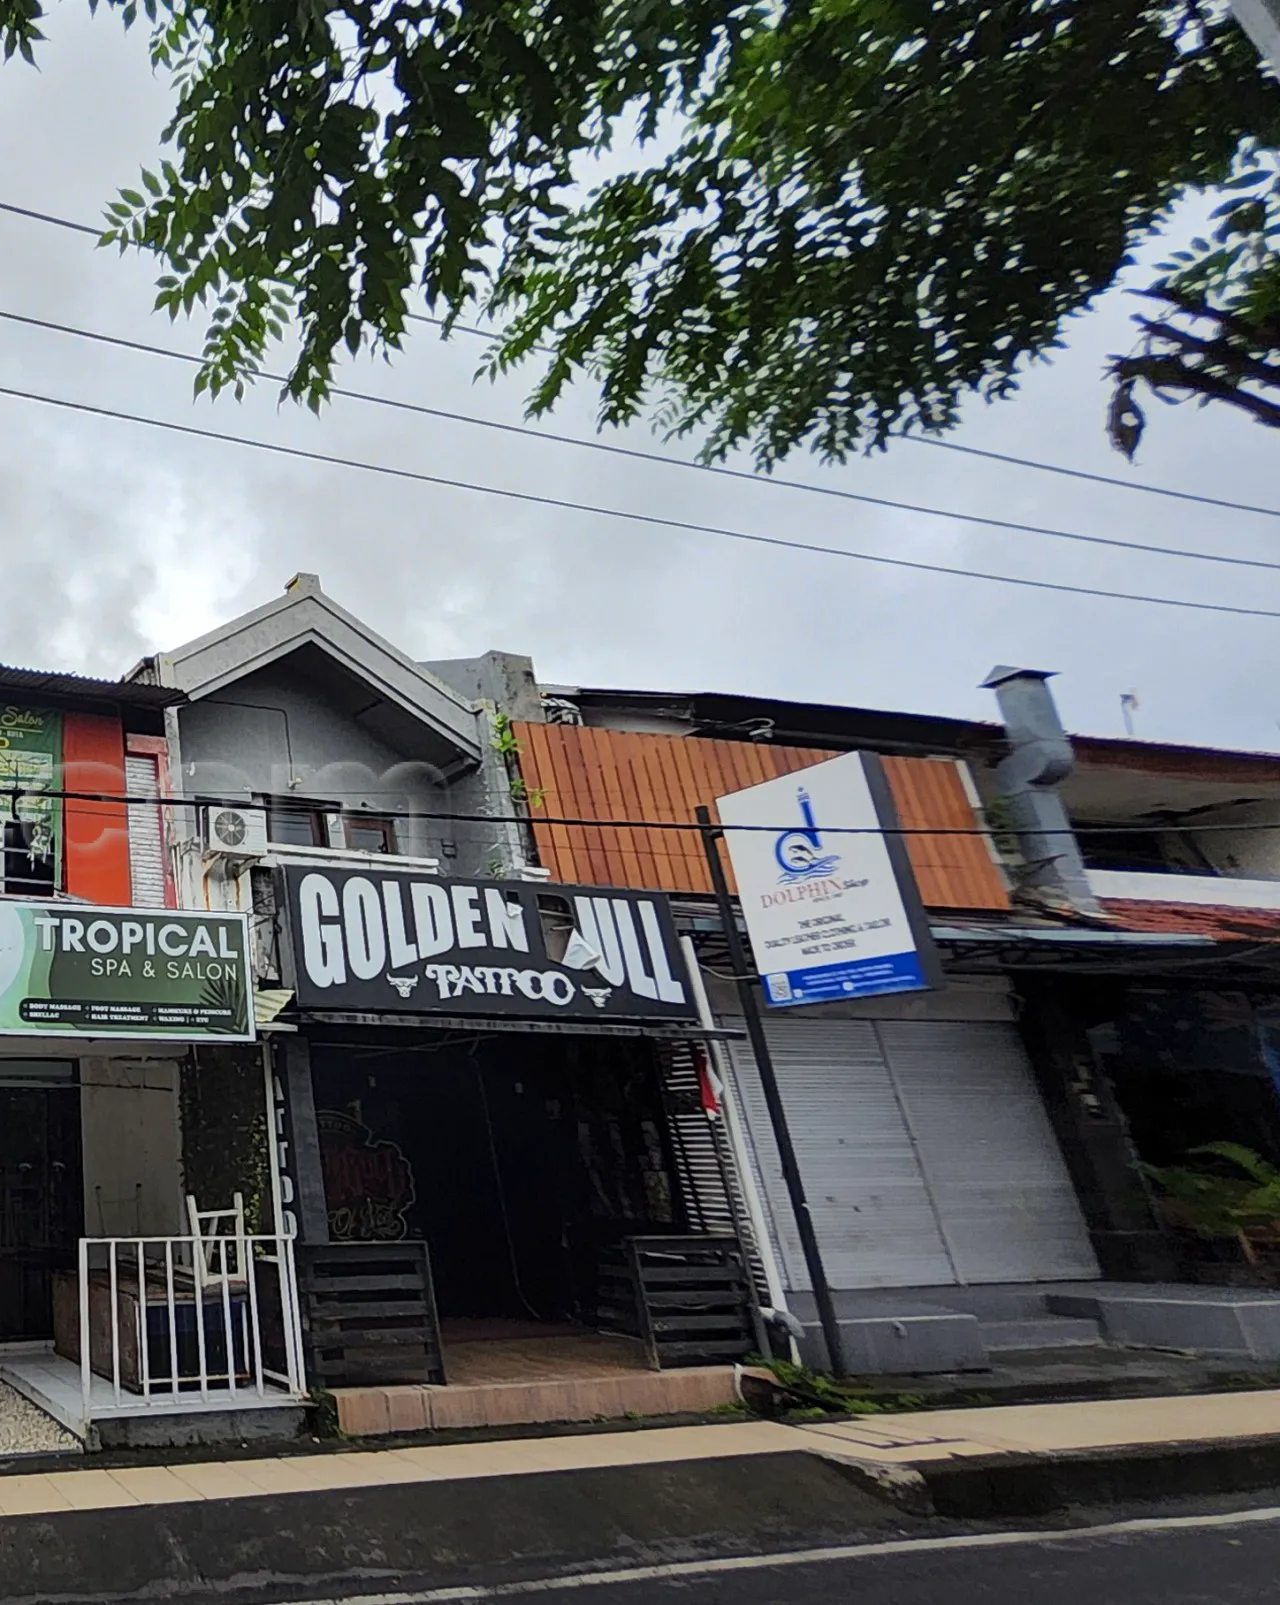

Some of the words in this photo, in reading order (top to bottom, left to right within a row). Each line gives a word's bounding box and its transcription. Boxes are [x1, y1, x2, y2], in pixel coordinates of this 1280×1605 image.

[1, 706, 44, 726] Salon
[760, 879, 842, 909] DOLPHIN
[34, 918, 238, 959] TROPICAL
[298, 873, 530, 989] GOLDEN
[536, 894, 687, 1005] ULL
[90, 958, 132, 978] SPA
[142, 960, 157, 978] &
[166, 961, 238, 982] SALON
[425, 963, 577, 1006] TATTOO
[49, 1003, 82, 1012] MASSAGE
[109, 1014, 149, 1022] TREATMENT
